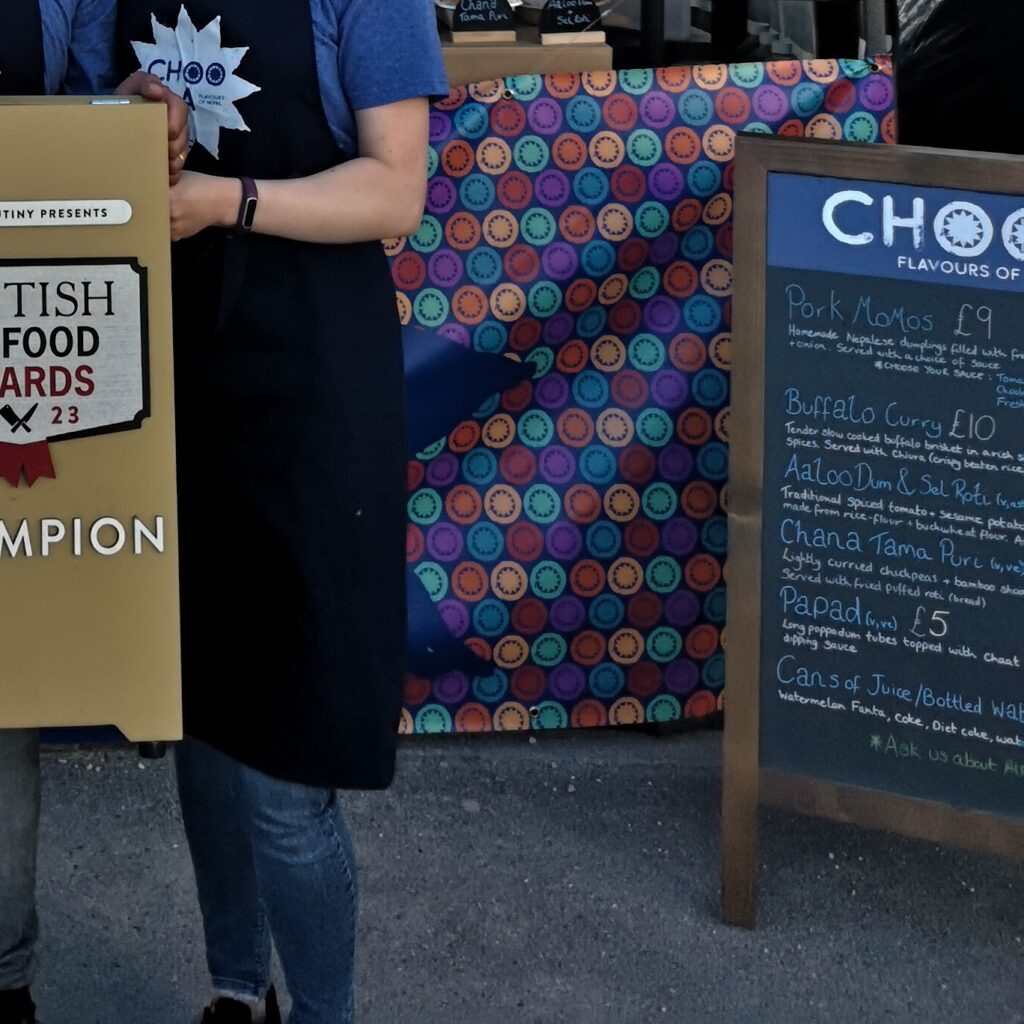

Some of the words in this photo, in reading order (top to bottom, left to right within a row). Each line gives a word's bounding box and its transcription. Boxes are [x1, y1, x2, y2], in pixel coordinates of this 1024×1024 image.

[147, 59, 226, 87] CHOO
[40, 208, 108, 219] PRESENTS
[897, 256, 990, 278] FLAVOURS
[996, 267, 1021, 281] OF
[785, 284, 844, 320] Pork
[954, 304, 992, 340] £9
[2, 326, 100, 358] FOOD
[788, 324, 839, 340] Homemade
[846, 332, 895, 347] Nepalese
[900, 337, 947, 355] dumplings
[950, 341, 978, 355] filled
[981, 346, 1008, 358] with
[836, 342, 873, 356] Served
[877, 348, 902, 360] with
[915, 351, 947, 364] choice
[952, 356, 966, 369] of
[925, 364, 950, 376] YOUR
[51, 406, 79, 425] 23
[785, 387, 875, 424] Buffalo
[885, 402, 941, 438] Curry
[949, 409, 996, 440] £10
[785, 421, 818, 435] Tender
[822, 428, 844, 439] slow
[847, 432, 880, 443] cooked
[884, 434, 921, 449] buffalo
[925, 440, 963, 454] brisket
[967, 446, 979, 456] in
[824, 439, 861, 453] Served
[863, 446, 887, 457] with
[964, 459, 999, 472] beaten
[784, 453, 853, 487] Aaloo
[853, 462, 892, 491] Dum
[896, 467, 916, 496] &
[919, 474, 948, 497] Sel
[951, 478, 991, 505] Roti
[780, 484, 841, 506] Traditional
[888, 500, 927, 517] tomato
[783, 502, 812, 513] made
[814, 504, 840, 517] from
[915, 519, 976, 537] buckwheat
[780, 518, 862, 553] Chana
[869, 531, 933, 561] Tama
[781, 568, 821, 584] Served
[825, 575, 852, 587] with
[854, 578, 881, 591] fried
[885, 582, 920, 598] puffed
[782, 547, 821, 571] Lightly
[828, 558, 873, 572] curried
[880, 566, 938, 583] chickpeas
[954, 576, 995, 592] bamboo
[779, 585, 861, 625] Papad
[909, 605, 950, 637] £5
[782, 619, 805, 636] Long
[807, 624, 861, 639] poppadum
[866, 631, 897, 645] tubes
[903, 637, 942, 655] topped
[948, 644, 977, 659] with
[784, 633, 818, 651] dipping
[776, 654, 840, 688] Cans
[844, 675, 861, 693] of
[778, 689, 846, 711] Watermelon
[932, 720, 958, 734] Diet
[929, 748, 948, 763] us
[953, 753, 997, 772] about
